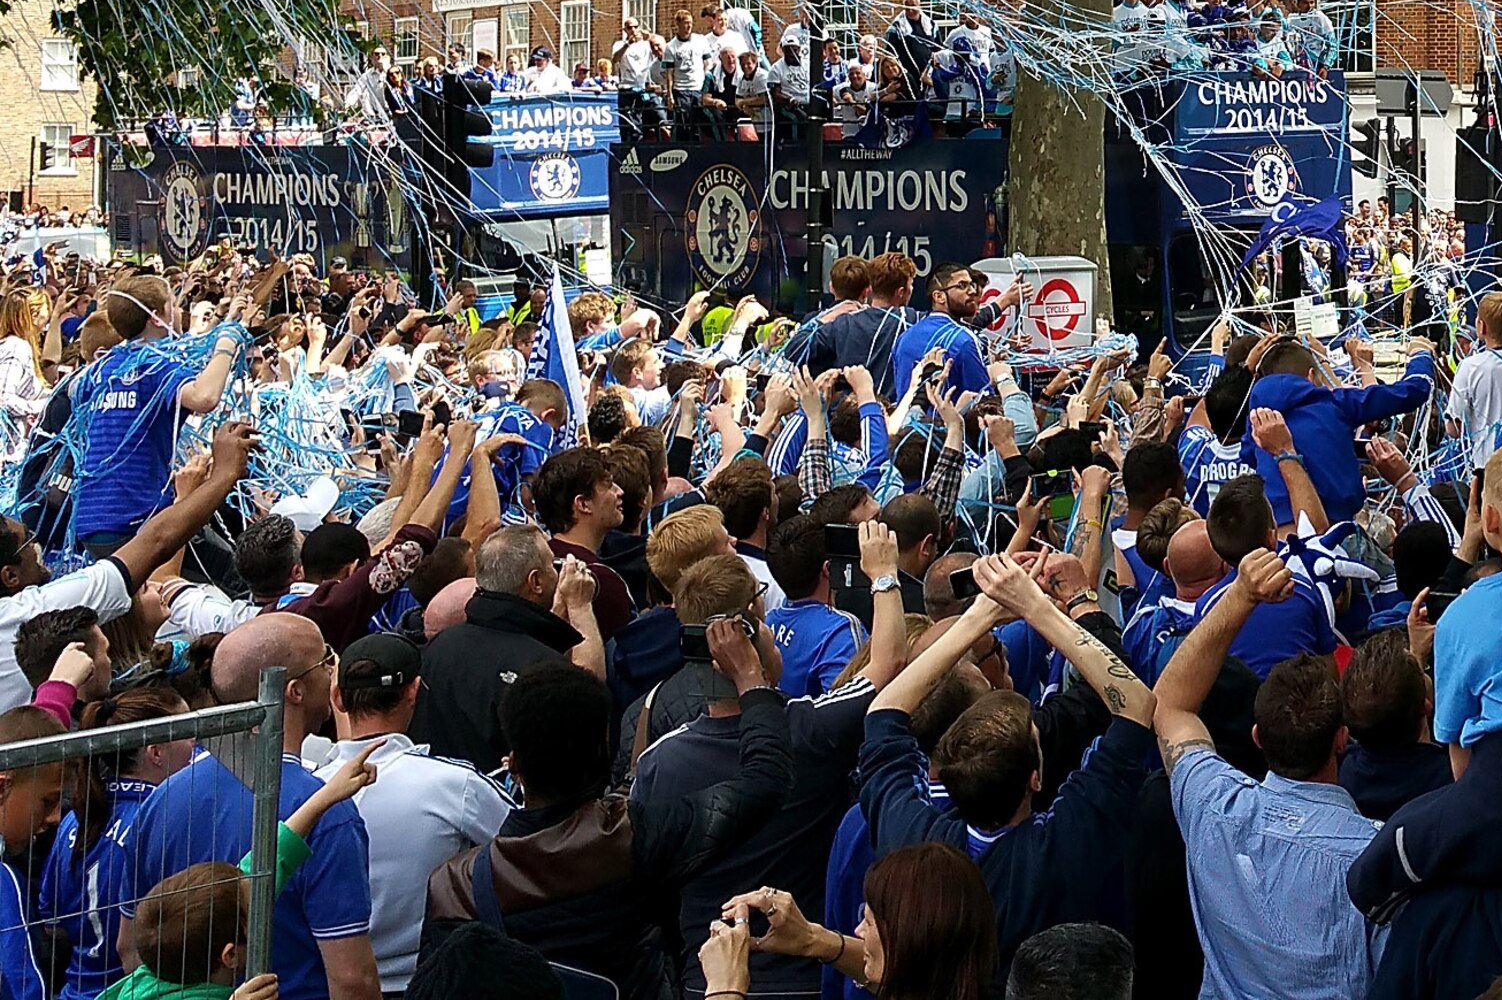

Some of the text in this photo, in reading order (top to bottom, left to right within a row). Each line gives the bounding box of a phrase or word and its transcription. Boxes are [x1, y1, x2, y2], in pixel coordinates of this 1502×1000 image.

[1198, 80, 1328, 104] CHAMPIONS
[490, 105, 612, 130] CHAMPIONS
[1225, 107, 1308, 136] 2014/15
[512, 126, 596, 152] 2014/15
[840, 149, 893, 160] #ALLTHEWAY
[213, 172, 341, 208] CHAMPIONS
[697, 168, 747, 198] CHELSEA
[803, 231, 932, 278] 014/15
[1045, 304, 1070, 314] CYCLES
[1199, 462, 1257, 482] DROGB
